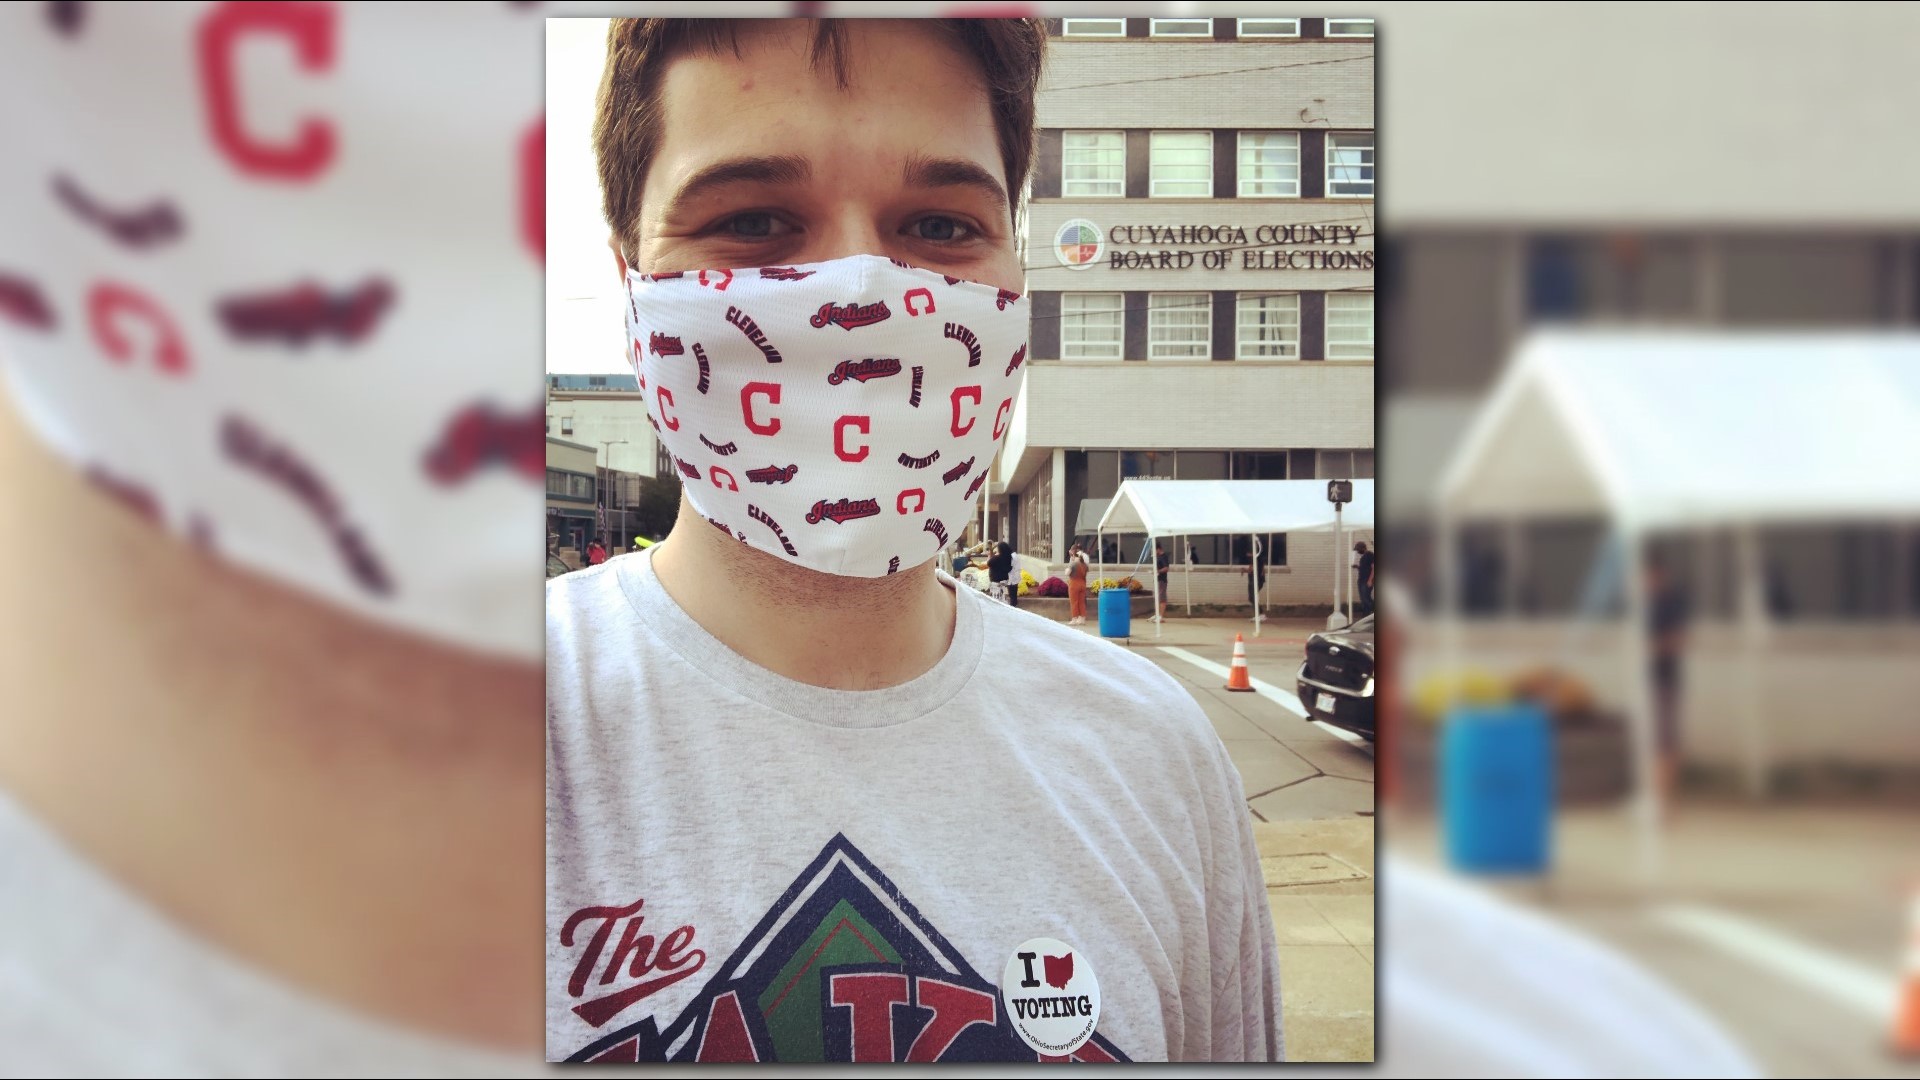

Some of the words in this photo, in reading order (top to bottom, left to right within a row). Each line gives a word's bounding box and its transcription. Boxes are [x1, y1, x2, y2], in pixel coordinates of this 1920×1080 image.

[1109, 224, 1248, 244] CUYAHOGA
[1256, 224, 1361, 246] COUNTY
[1109, 250, 1194, 270] BOARD
[1202, 250, 1232, 270] OF
[1243, 250, 1374, 270] ELECTIONS
[810, 300, 891, 331] Indians
[904, 288, 936, 316] C
[725, 306, 782, 363] CLEVELAND
[944, 322, 982, 368] CLEVELAND
[828, 358, 902, 386] Indians
[657, 385, 680, 432] C
[740, 382, 782, 437] C
[950, 385, 982, 438] C
[833, 415, 870, 463] C
[805, 498, 881, 525] Indians
[897, 488, 925, 515] C
[748, 504, 798, 557] CLEVELAND
[561, 898, 706, 1028] The
[1017, 952, 1040, 988] I
[1012, 995, 1092, 1020] VOTING
[1018, 1019, 1094, 1051] www.OhioSecretaryofState.gov
